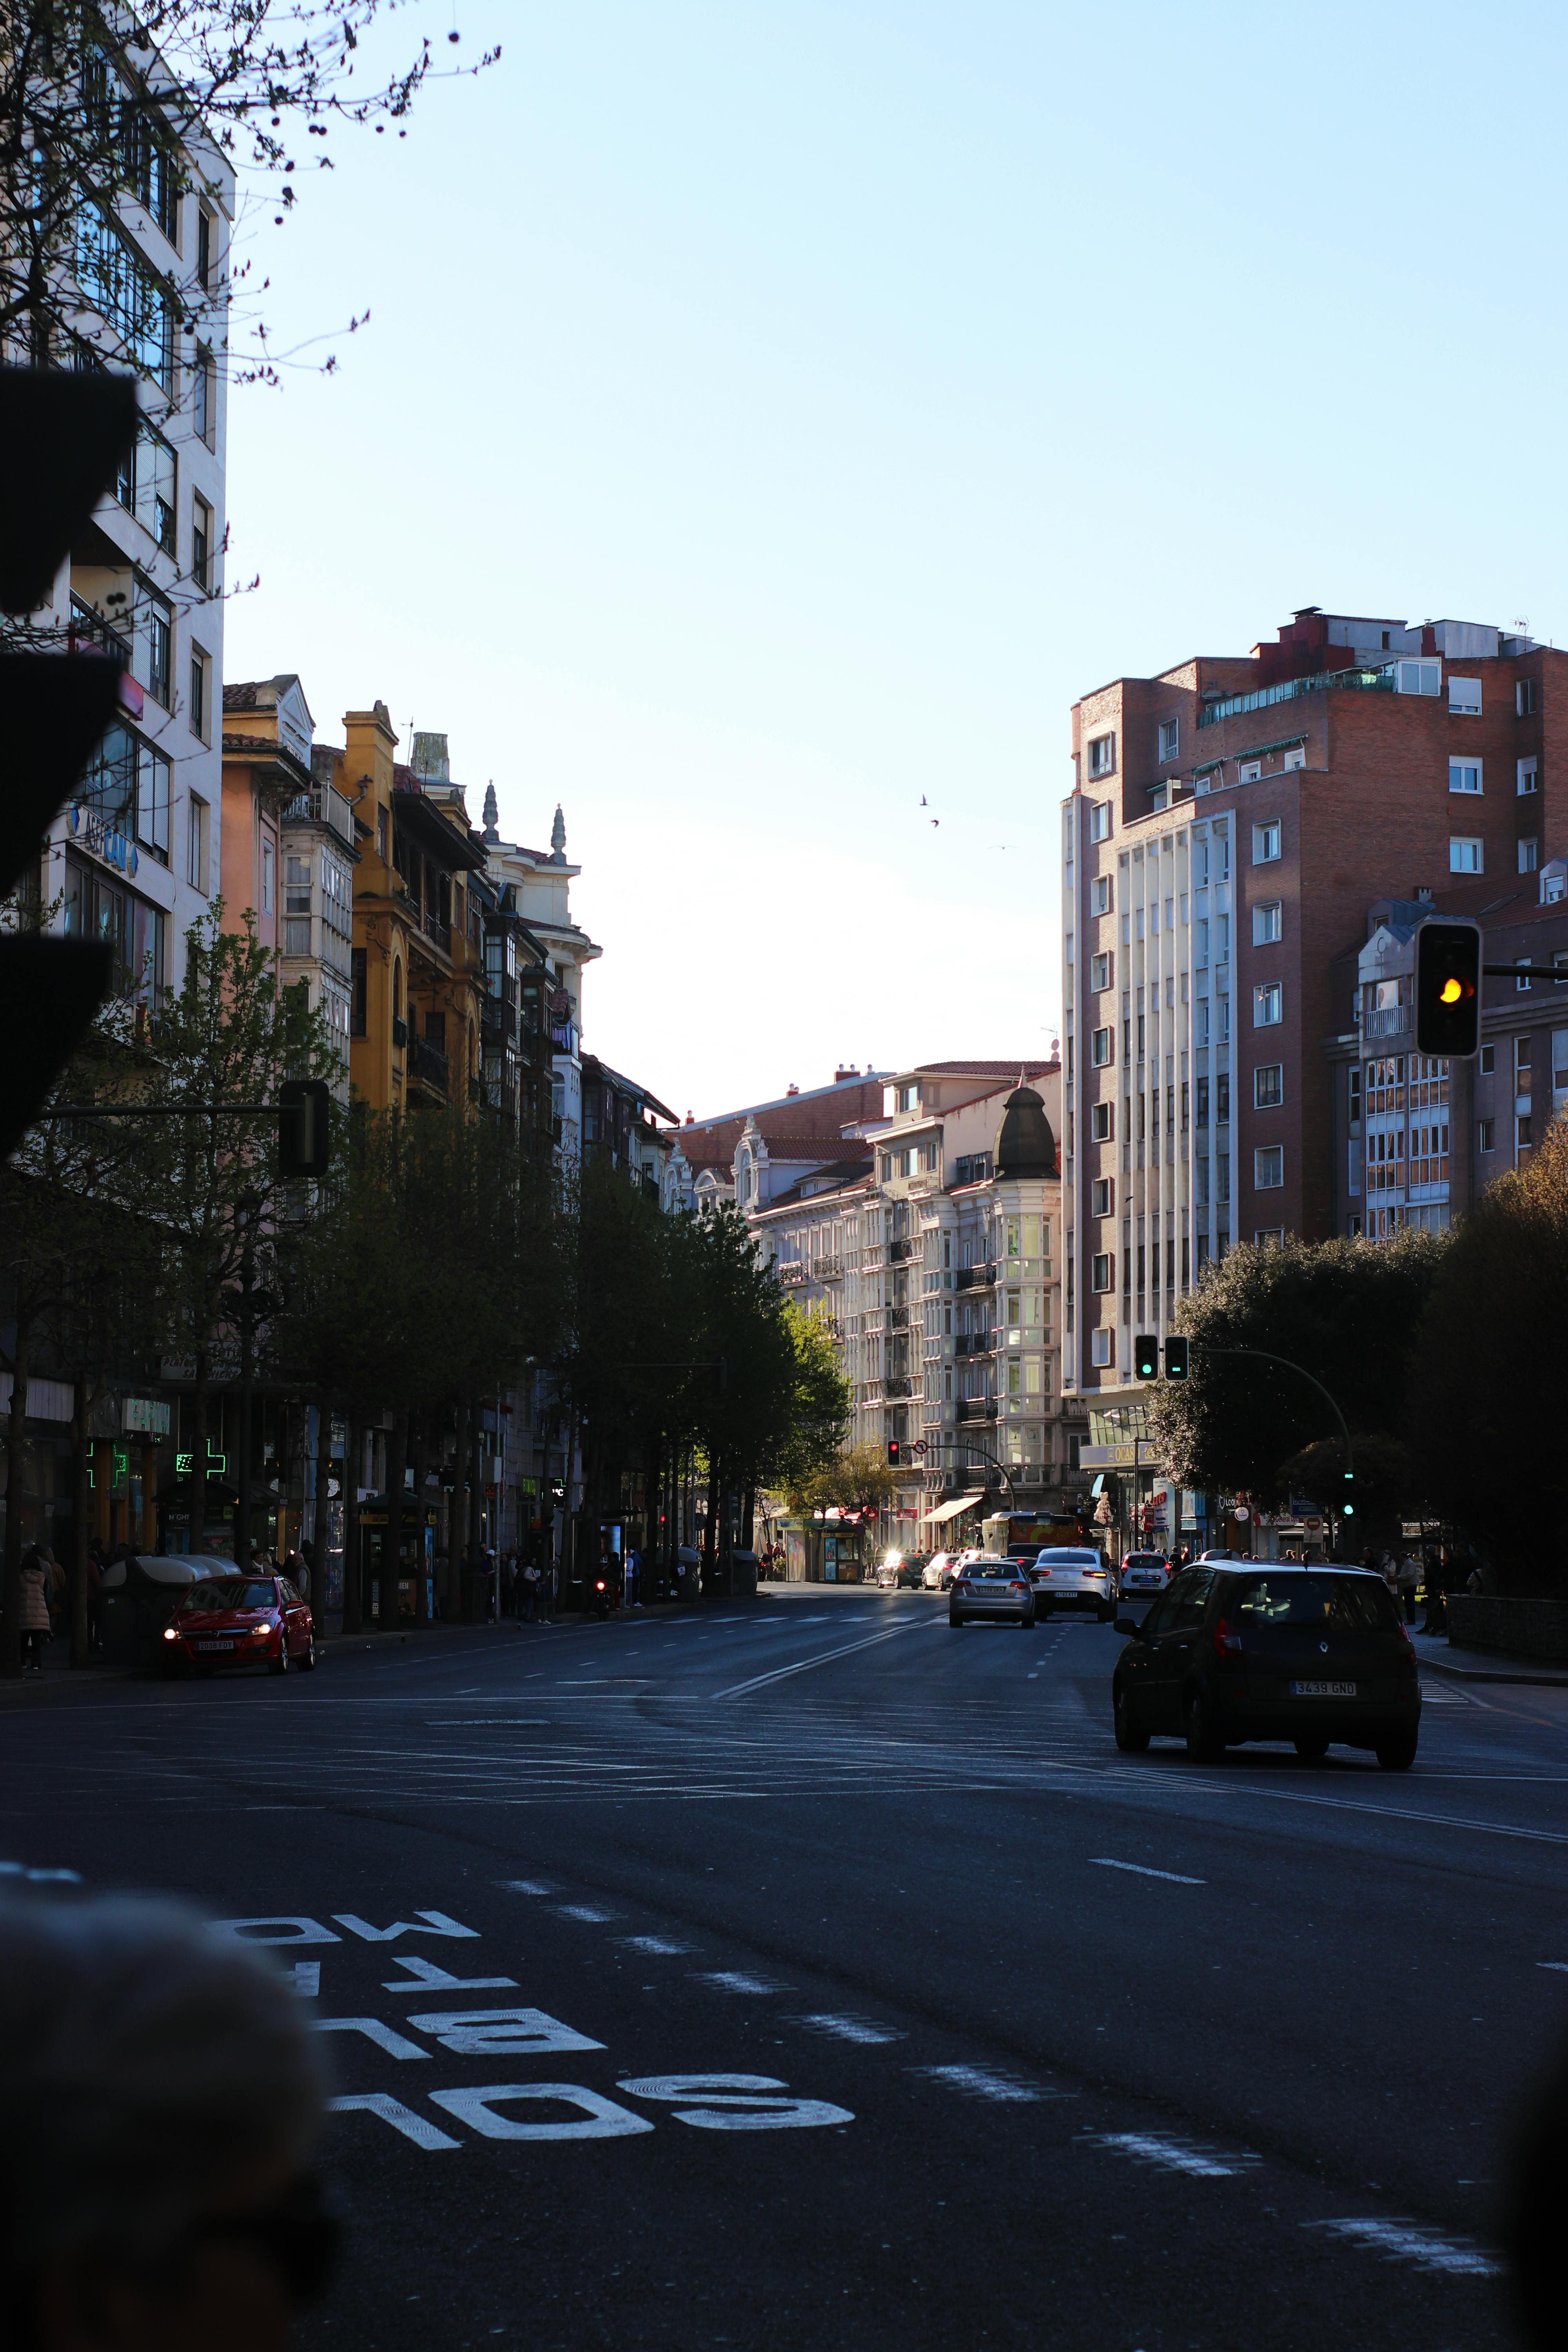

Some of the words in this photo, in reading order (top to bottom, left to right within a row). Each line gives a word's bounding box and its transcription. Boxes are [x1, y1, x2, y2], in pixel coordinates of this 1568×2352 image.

[1298, 1682, 1328, 1693] 3439
[1332, 1683, 1354, 1694] GND
[201, 1910, 483, 1947] MO
[325, 2073, 856, 2151] SOL
